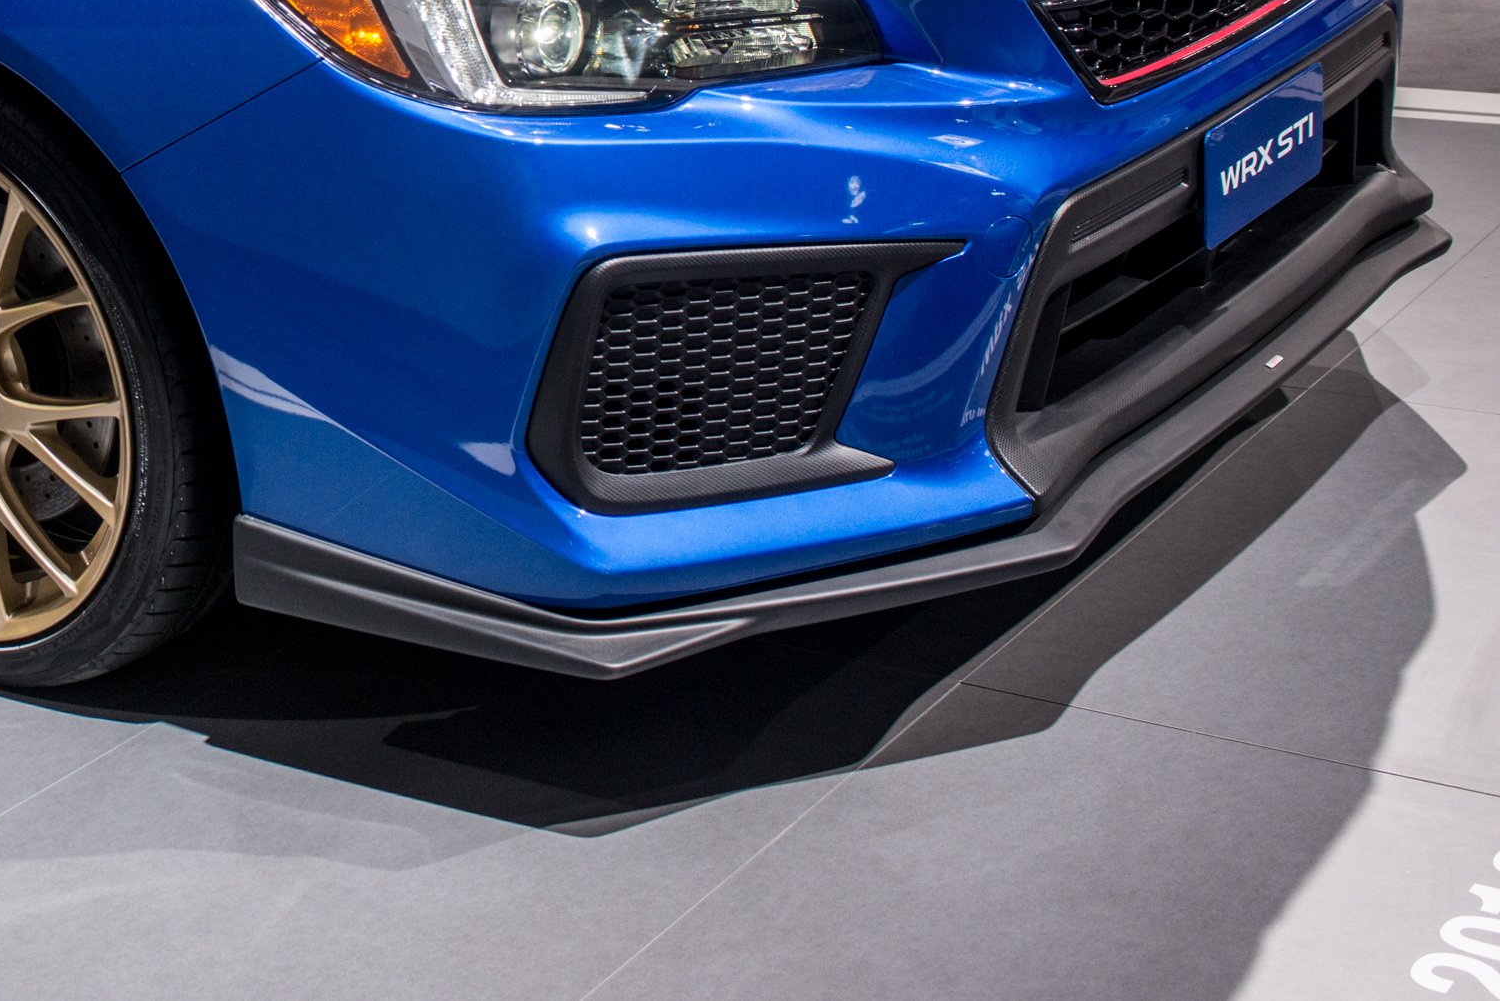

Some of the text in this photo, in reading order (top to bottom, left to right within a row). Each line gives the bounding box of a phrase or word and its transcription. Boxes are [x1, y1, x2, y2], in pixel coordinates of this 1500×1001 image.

[1220, 111, 1314, 196] WRX STI
[1410, 851, 1500, 1001] 20
